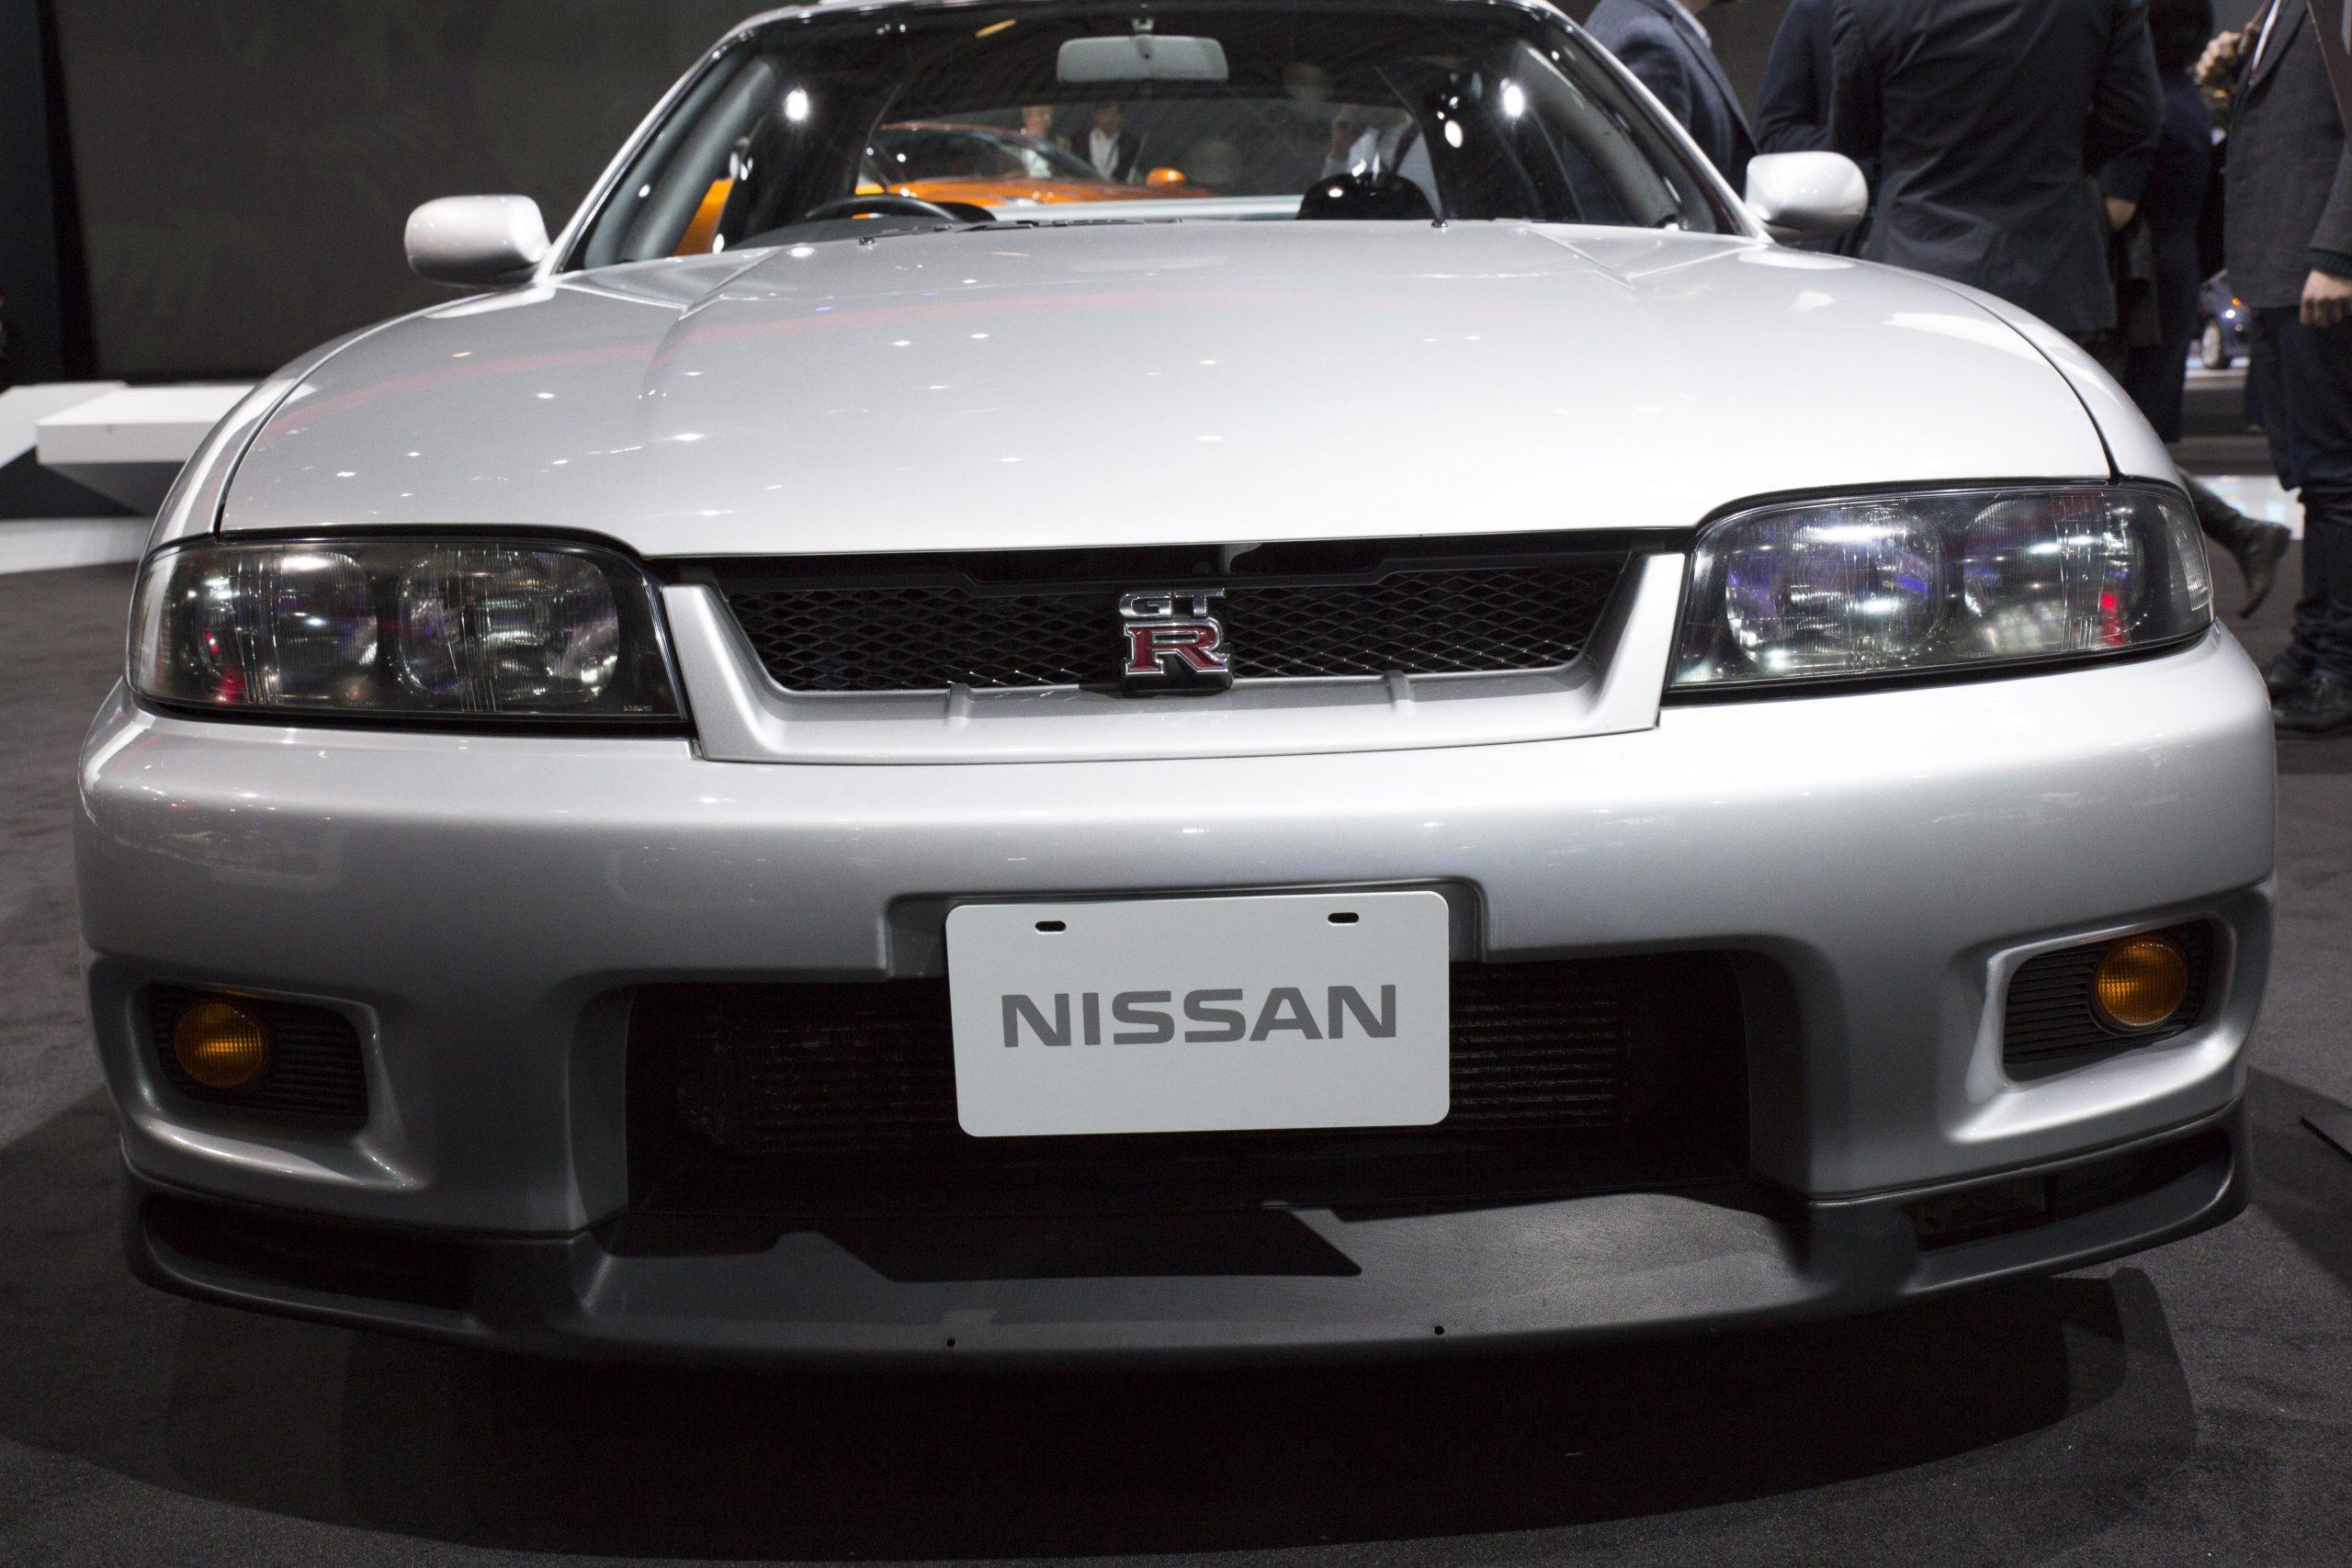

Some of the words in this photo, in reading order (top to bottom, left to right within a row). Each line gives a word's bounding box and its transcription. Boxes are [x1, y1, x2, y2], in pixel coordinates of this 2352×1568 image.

[1119, 589, 1226, 617] GT
[1124, 617, 1230, 675] R
[1001, 984, 1396, 1048] NISSAN
